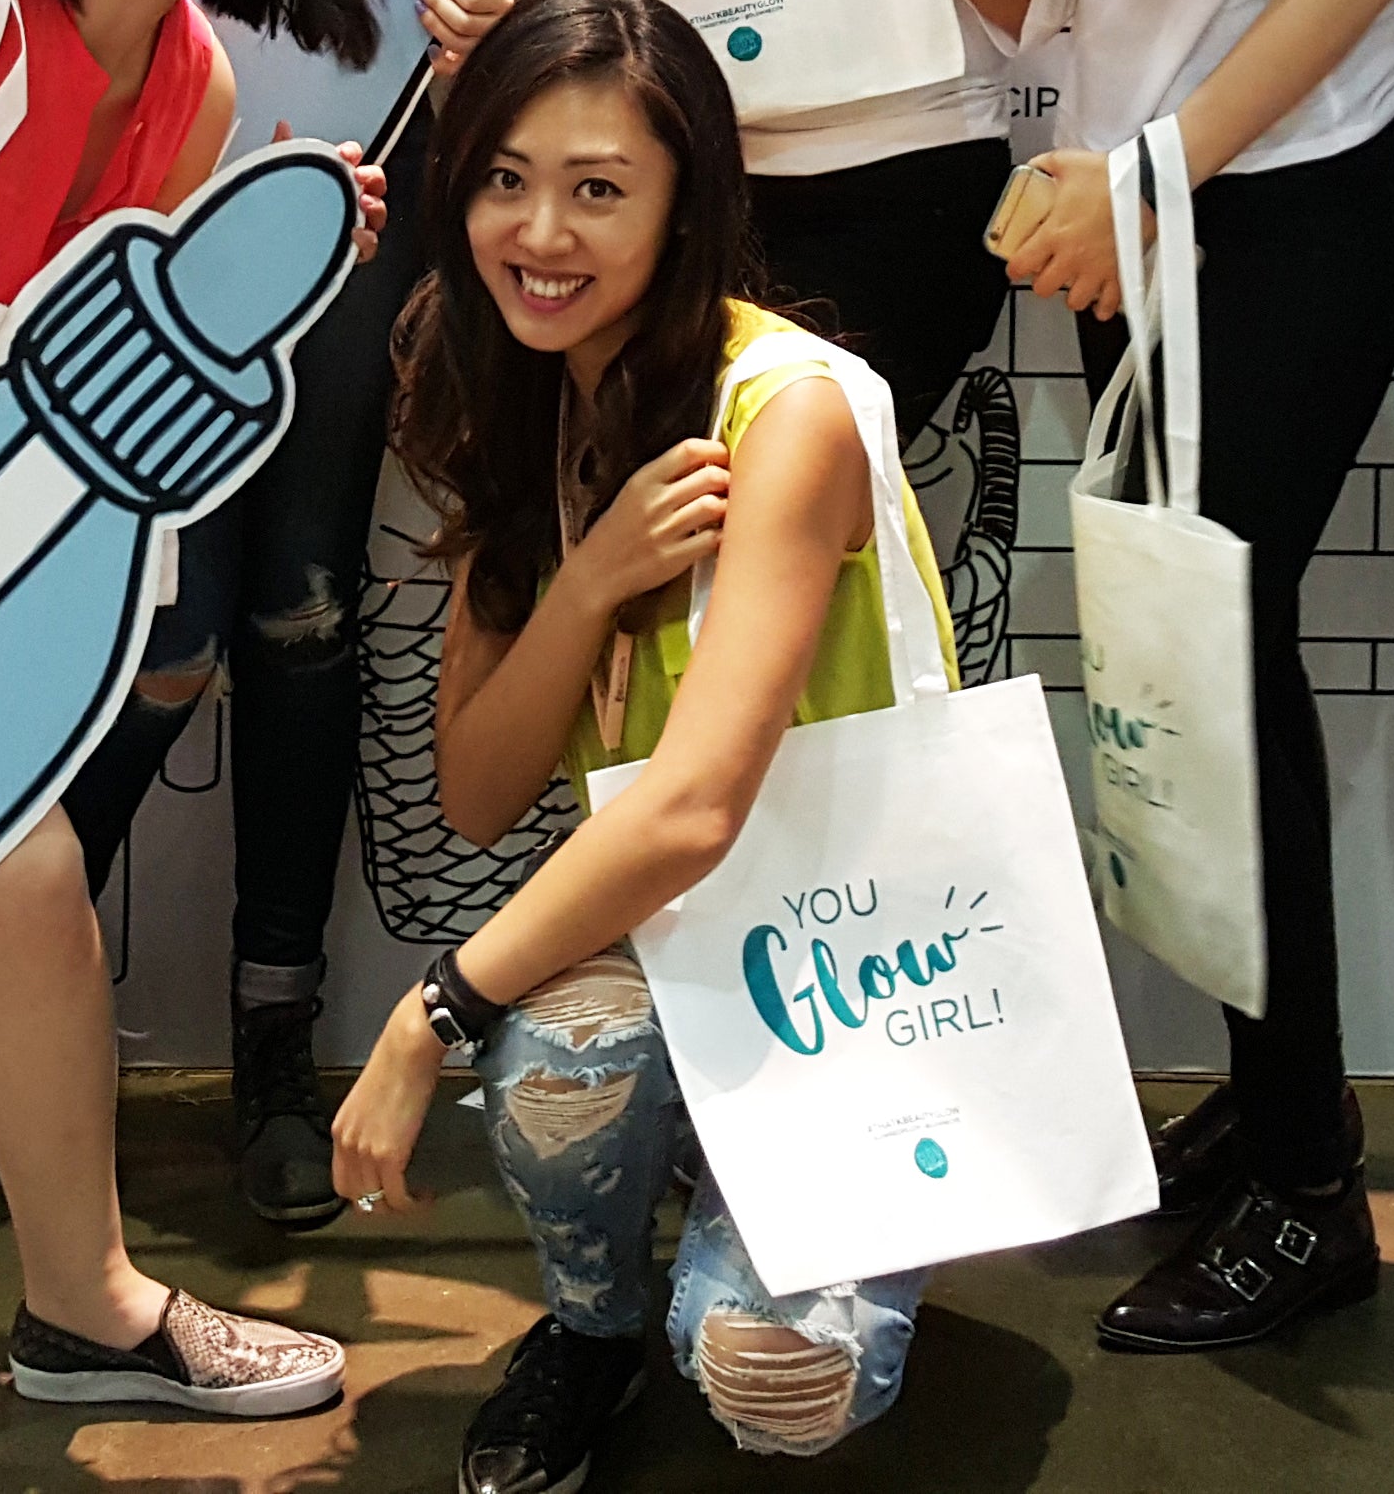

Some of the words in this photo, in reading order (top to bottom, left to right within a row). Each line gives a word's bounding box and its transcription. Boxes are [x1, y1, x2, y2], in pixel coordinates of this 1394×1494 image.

[782, 878, 878, 929] YOU
[742, 924, 969, 1056] Glow
[885, 988, 1004, 1047] GIRL!
